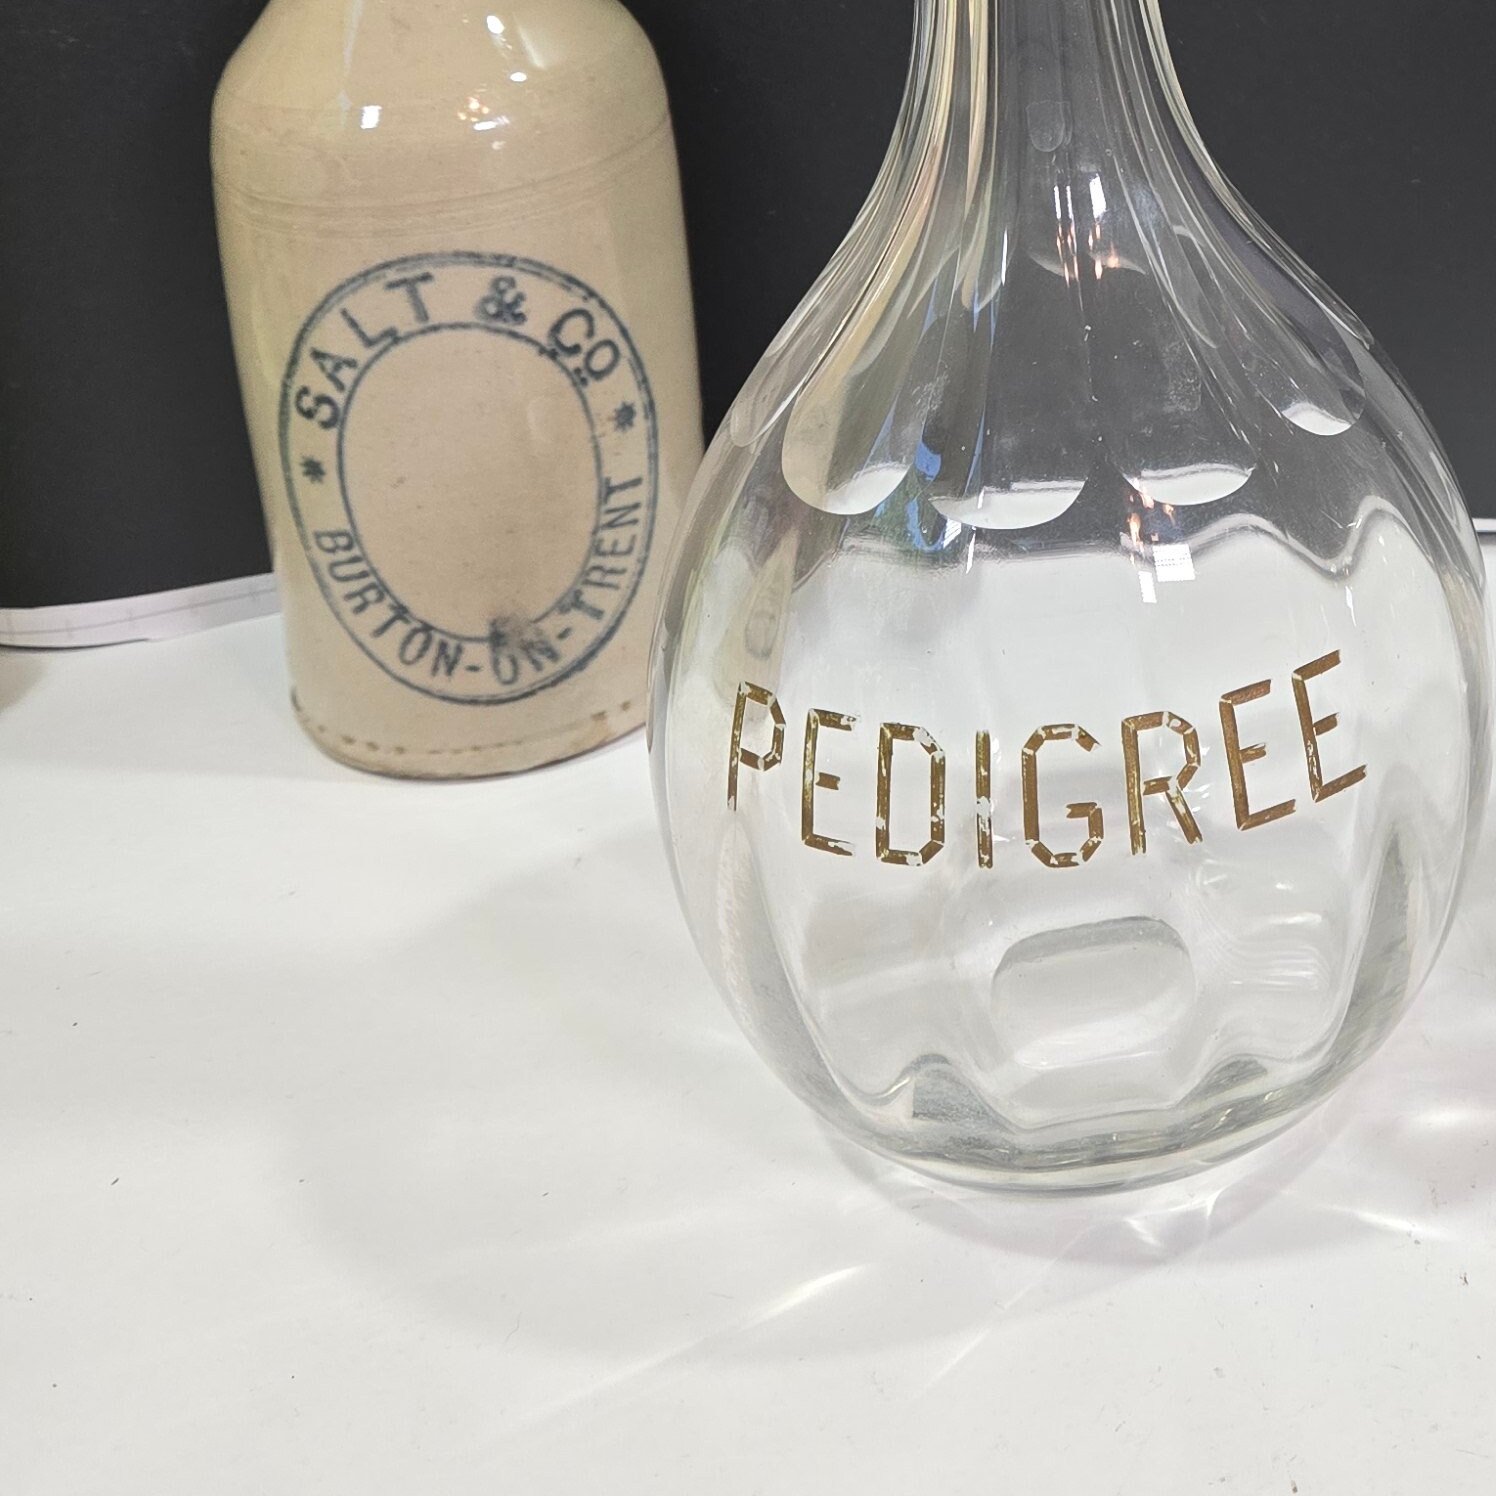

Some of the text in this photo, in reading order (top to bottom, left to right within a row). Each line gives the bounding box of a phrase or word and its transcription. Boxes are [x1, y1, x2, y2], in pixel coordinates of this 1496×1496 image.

[296, 272, 434, 430] SALT
[476, 276, 528, 325] &
[727, 649, 1368, 870] PEDIGREE
